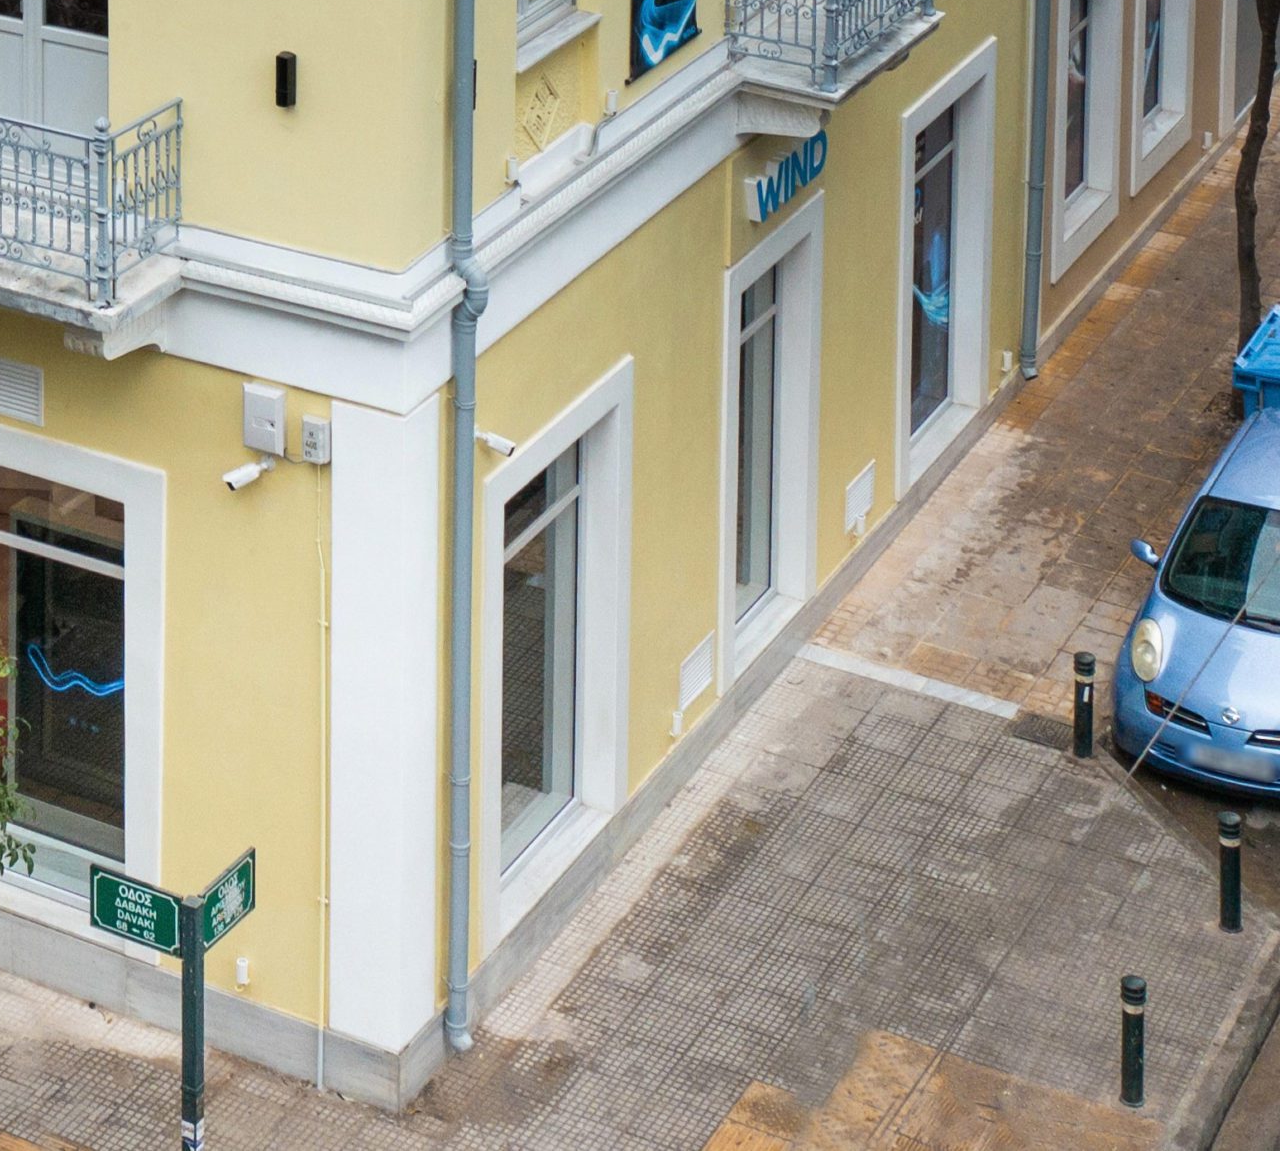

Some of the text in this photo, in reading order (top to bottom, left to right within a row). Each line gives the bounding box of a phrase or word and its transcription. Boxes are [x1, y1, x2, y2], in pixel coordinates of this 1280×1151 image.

[756, 129, 827, 223] WIND
[119, 885, 153, 907] ΟΔΟΣ
[114, 897, 157, 921] ΔΑΒΑΚΗ
[117, 908, 155, 931] DAVAKI
